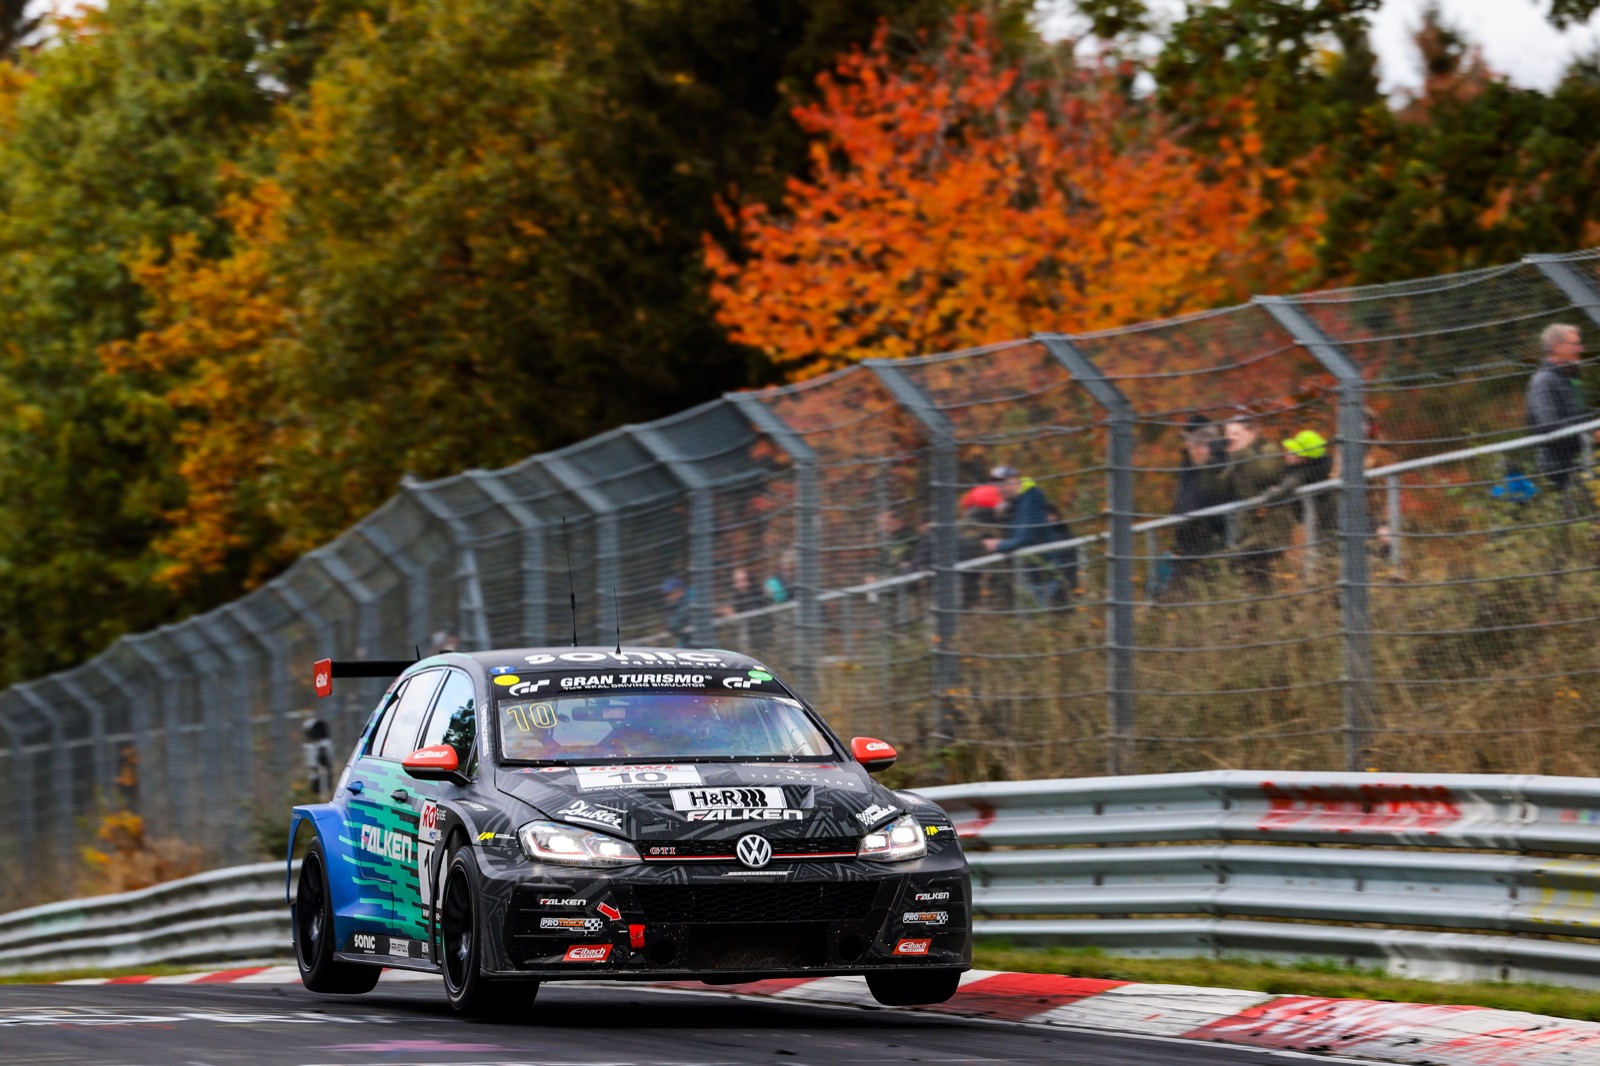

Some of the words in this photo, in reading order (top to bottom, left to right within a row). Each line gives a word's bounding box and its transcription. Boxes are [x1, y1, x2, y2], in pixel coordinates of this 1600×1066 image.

[560, 675, 613, 687] GRAN
[506, 702, 557, 732] 10
[608, 772, 668, 783] 10
[690, 790, 738, 807] H&R
[687, 809, 804, 822] FALKEN
[361, 824, 412, 864] FALKEN
[649, 846, 676, 855] GTI
[540, 898, 587, 906] FALKEN
[916, 892, 950, 901] FALKEN
